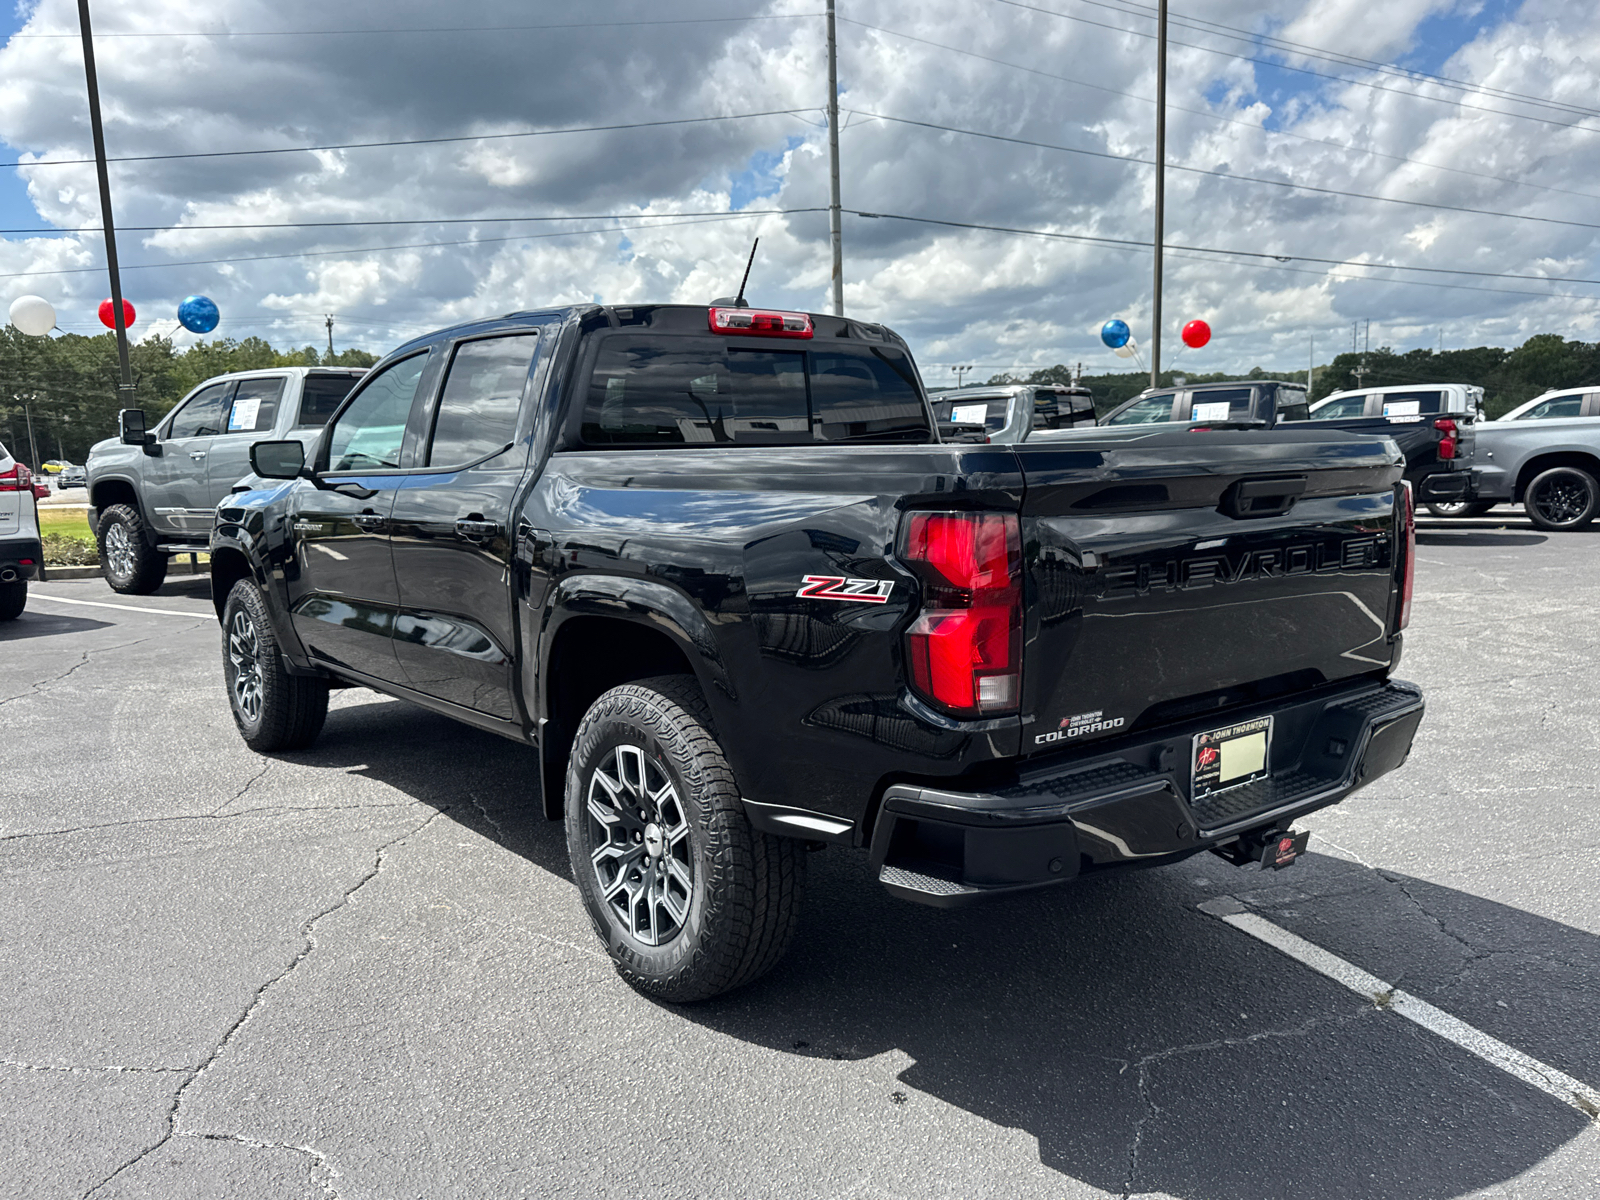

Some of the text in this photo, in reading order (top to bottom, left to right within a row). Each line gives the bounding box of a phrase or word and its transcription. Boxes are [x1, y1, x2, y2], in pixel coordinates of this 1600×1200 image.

[795, 574, 895, 604] Z71
[1034, 717, 1124, 745] COLORADO
[1069, 718, 1094, 728] CHEVROLET
[1212, 719, 1270, 740] JOHN THORNTON
[616, 932, 691, 976] WRANGLER
